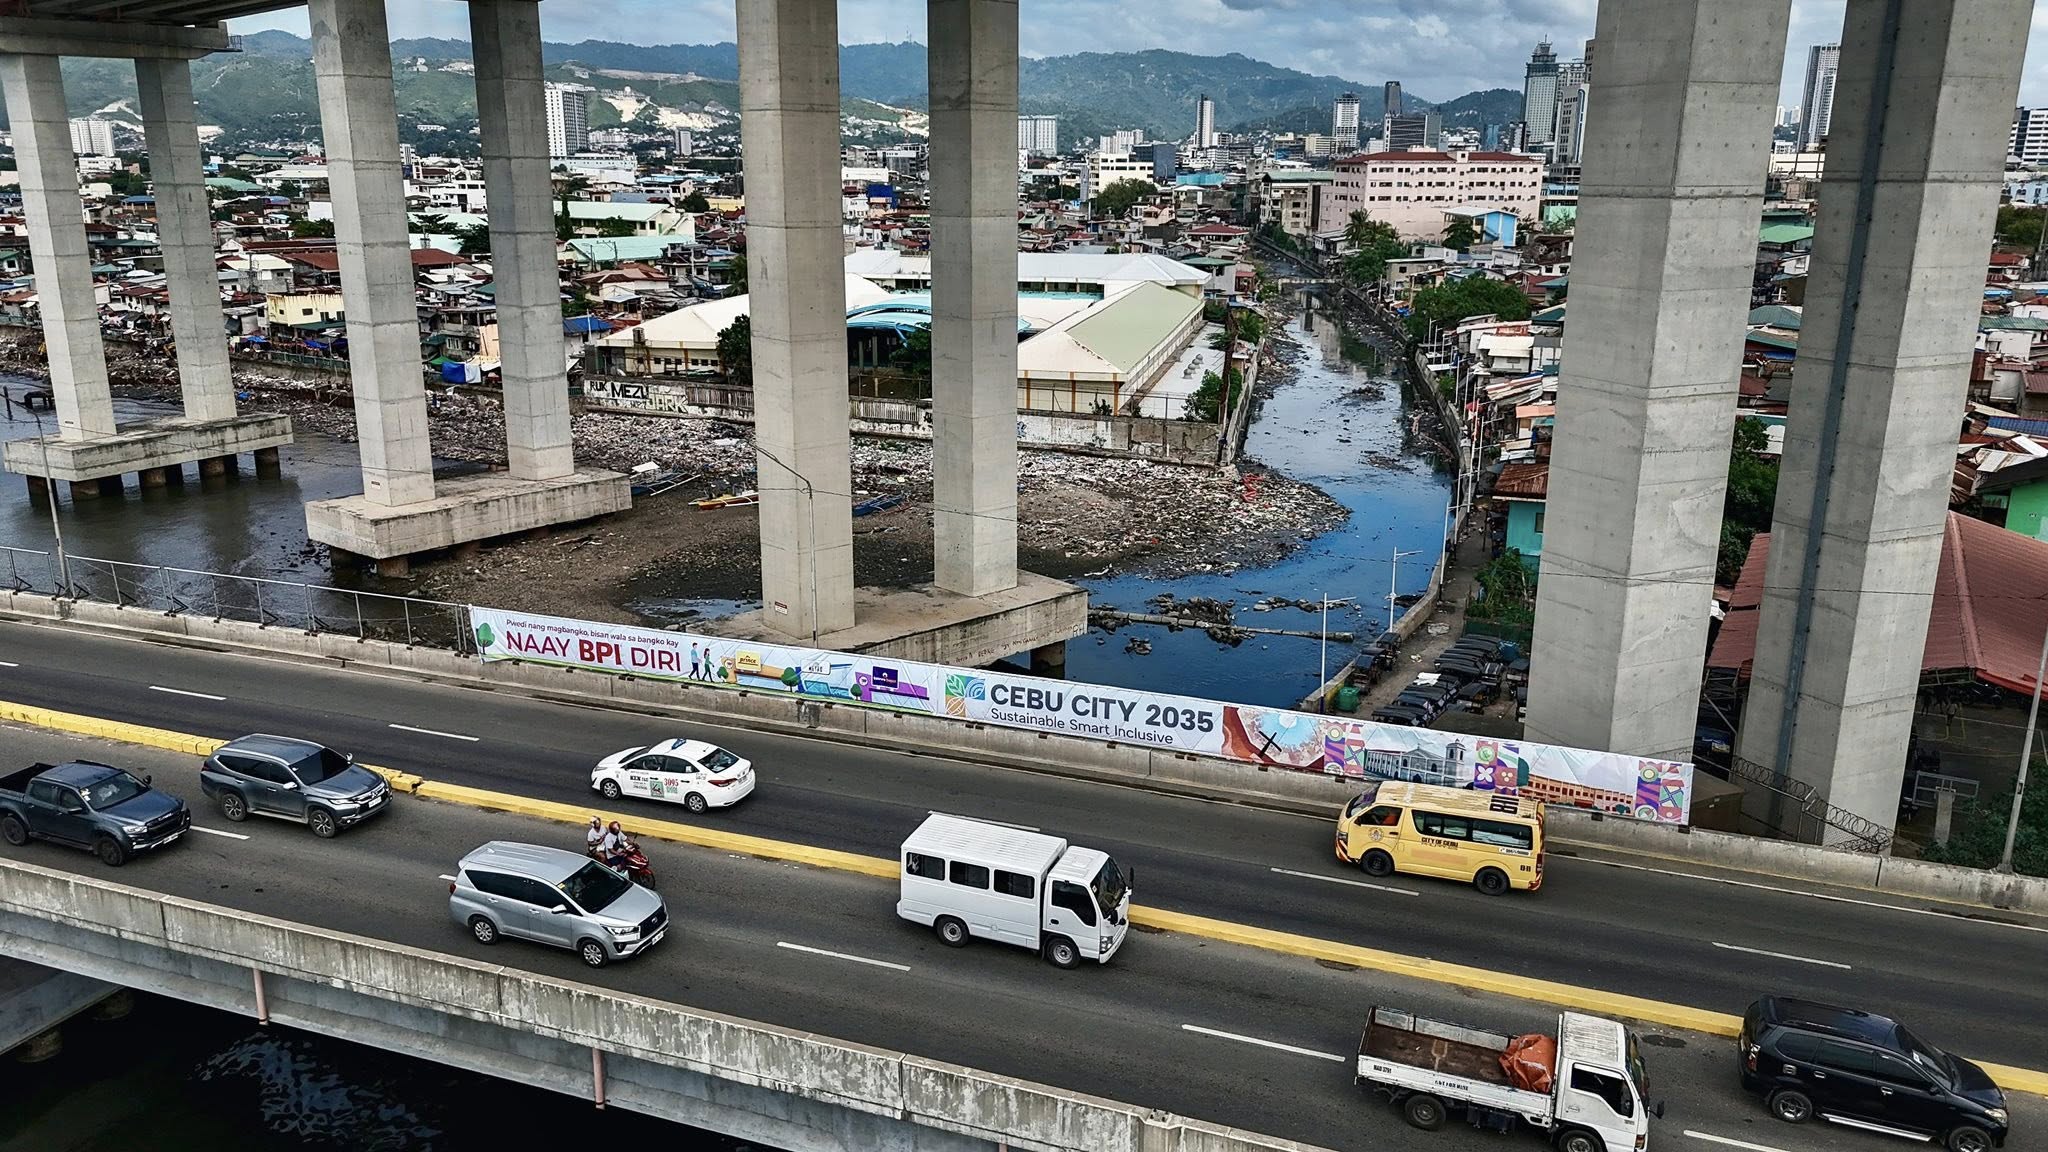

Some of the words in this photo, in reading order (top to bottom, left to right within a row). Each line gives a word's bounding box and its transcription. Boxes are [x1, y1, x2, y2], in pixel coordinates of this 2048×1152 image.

[506, 619, 527, 629] Pwedi
[528, 623, 546, 632] nang
[547, 625, 590, 636] magbangko,
[590, 630, 609, 639] bisan
[610, 633, 627, 641] wala
[637, 636, 665, 646] bangko
[666, 639, 679, 649] kay
[506, 630, 571, 657] NAAY
[579, 639, 622, 666] BPI
[630, 646, 681, 672] DIRI
[990, 684, 1063, 712] CEBU
[1071, 695, 1137, 723] CITY
[1145, 704, 1214, 733] 2035
[991, 708, 1065, 729] Sustainable
[1069, 719, 1111, 736] Smart
[1114, 725, 1173, 744] Inclusive
